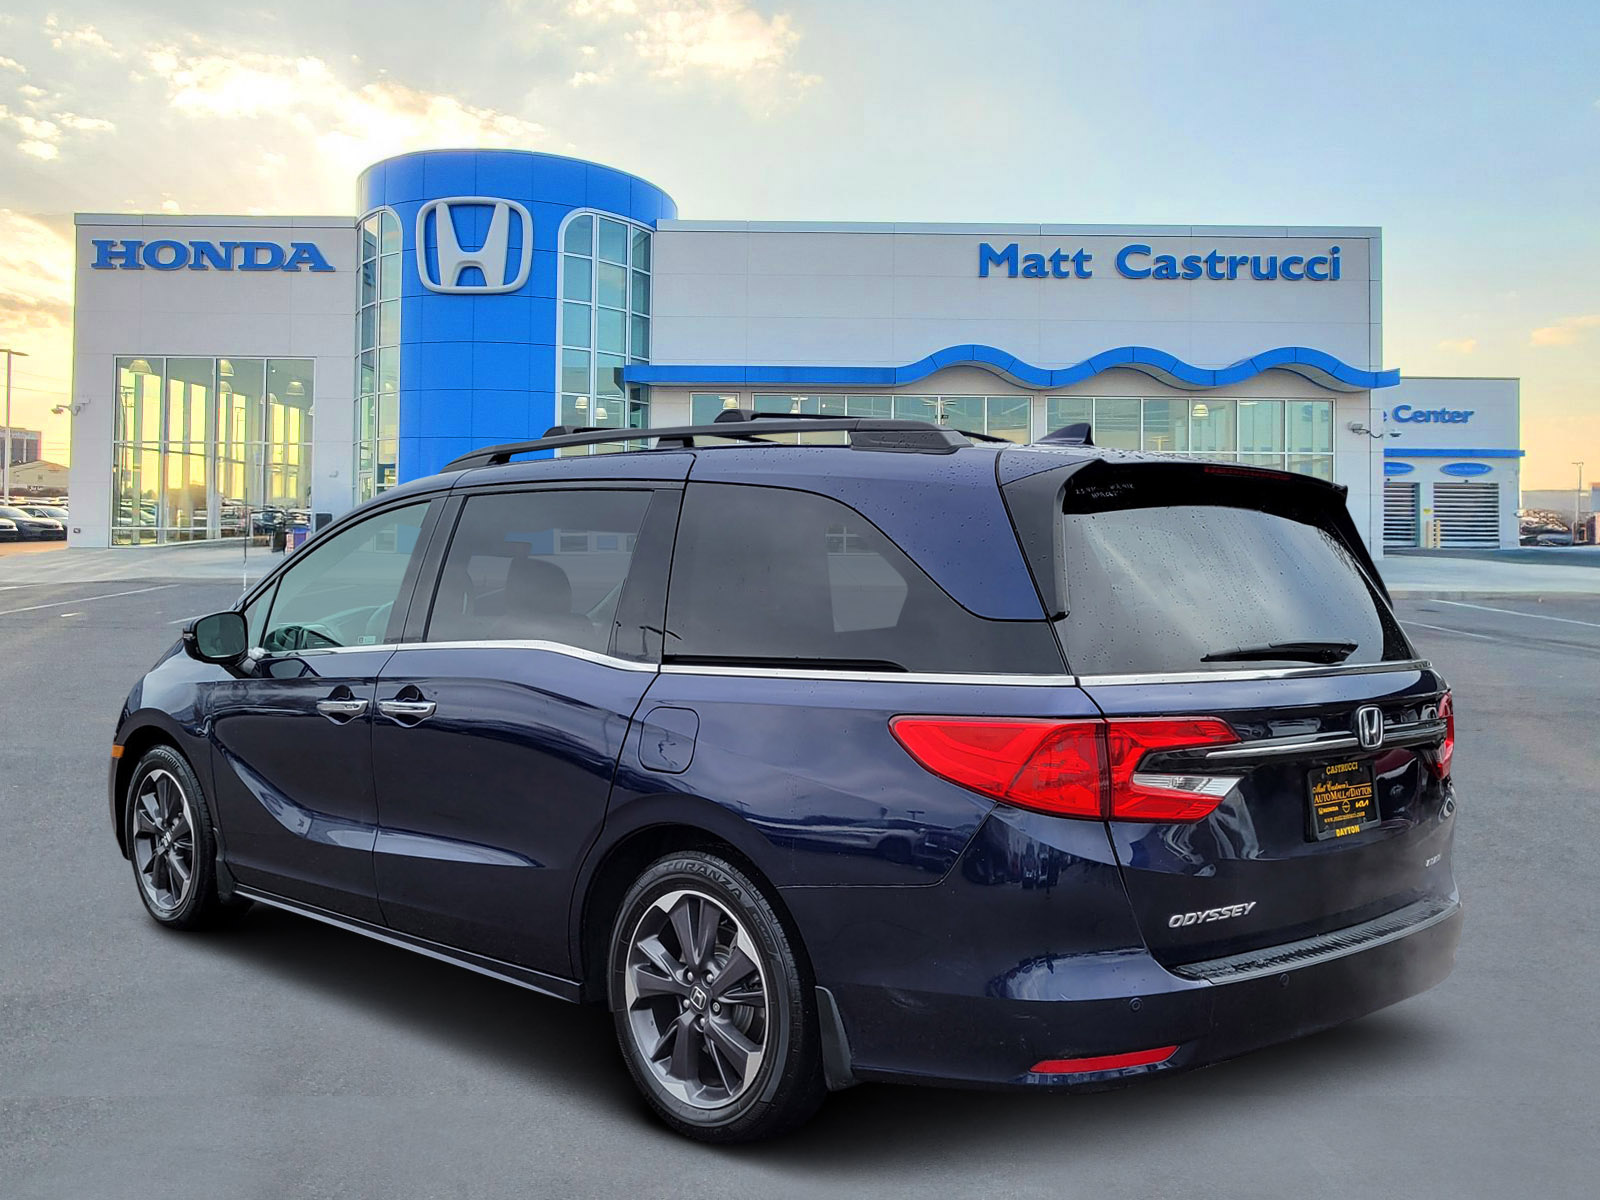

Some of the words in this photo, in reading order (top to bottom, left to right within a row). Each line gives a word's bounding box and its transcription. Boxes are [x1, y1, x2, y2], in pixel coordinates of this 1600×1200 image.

[92, 239, 336, 272] HONDA
[978, 242, 1094, 279] Matt
[1115, 244, 1342, 281] Castrucci
[1392, 404, 1475, 424] Center
[1326, 762, 1358, 775] CASTRUCCI
[1349, 786, 1372, 797] DAYTON
[1336, 825, 1360, 837] DAYTON
[664, 861, 743, 901] TURANZA
[1168, 902, 1256, 928] ODYSSEY
